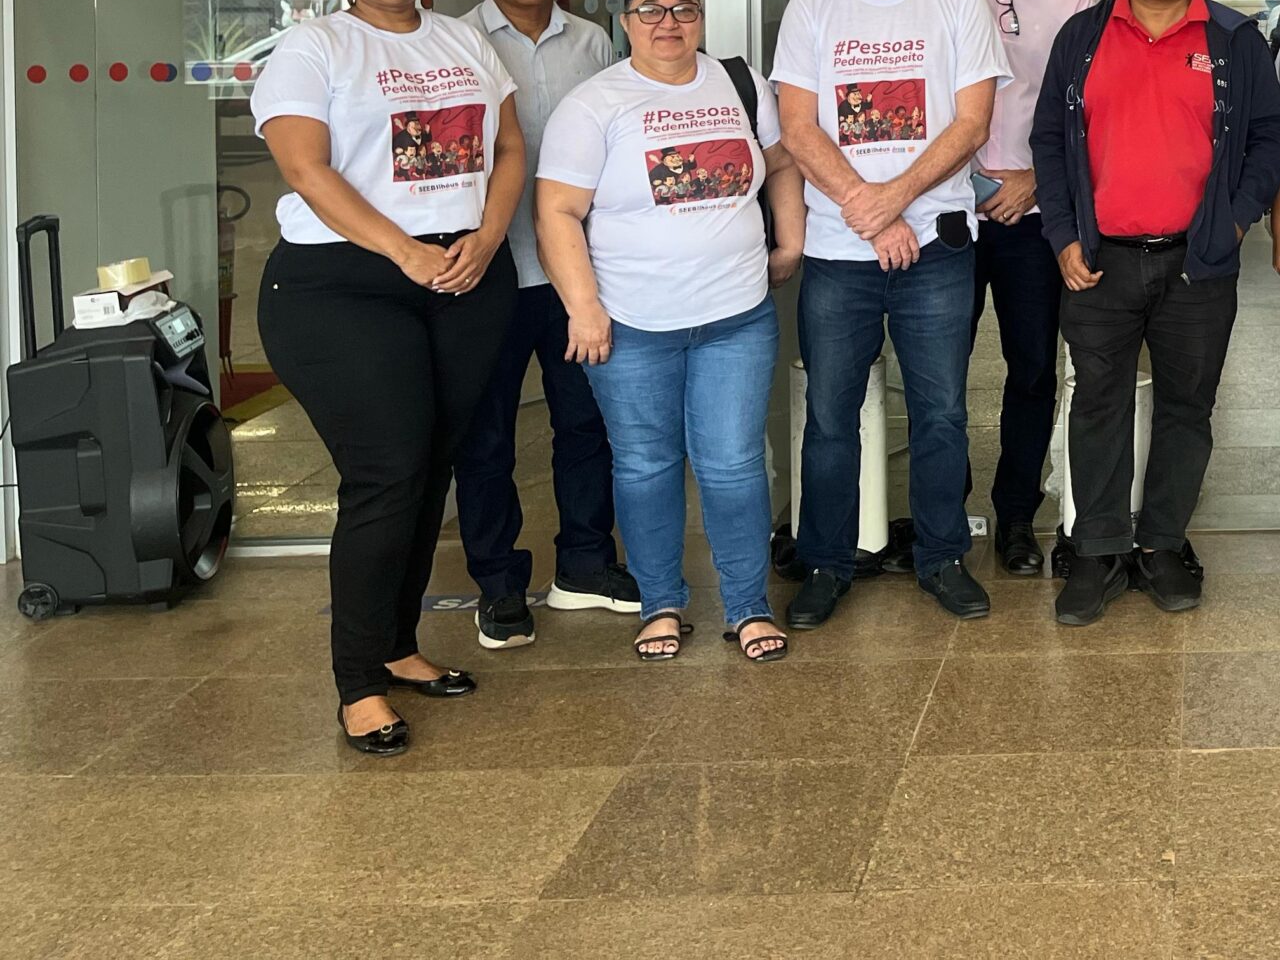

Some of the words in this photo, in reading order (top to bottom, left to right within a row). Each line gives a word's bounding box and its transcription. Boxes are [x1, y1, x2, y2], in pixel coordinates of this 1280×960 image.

[833, 40, 925, 56] #Pessoas
[833, 52, 924, 67] PedemRespeito
[376, 66, 474, 85] #Pessoas
[642, 106, 740, 125] #Pessoas
[643, 117, 741, 135] PedemRespeito
